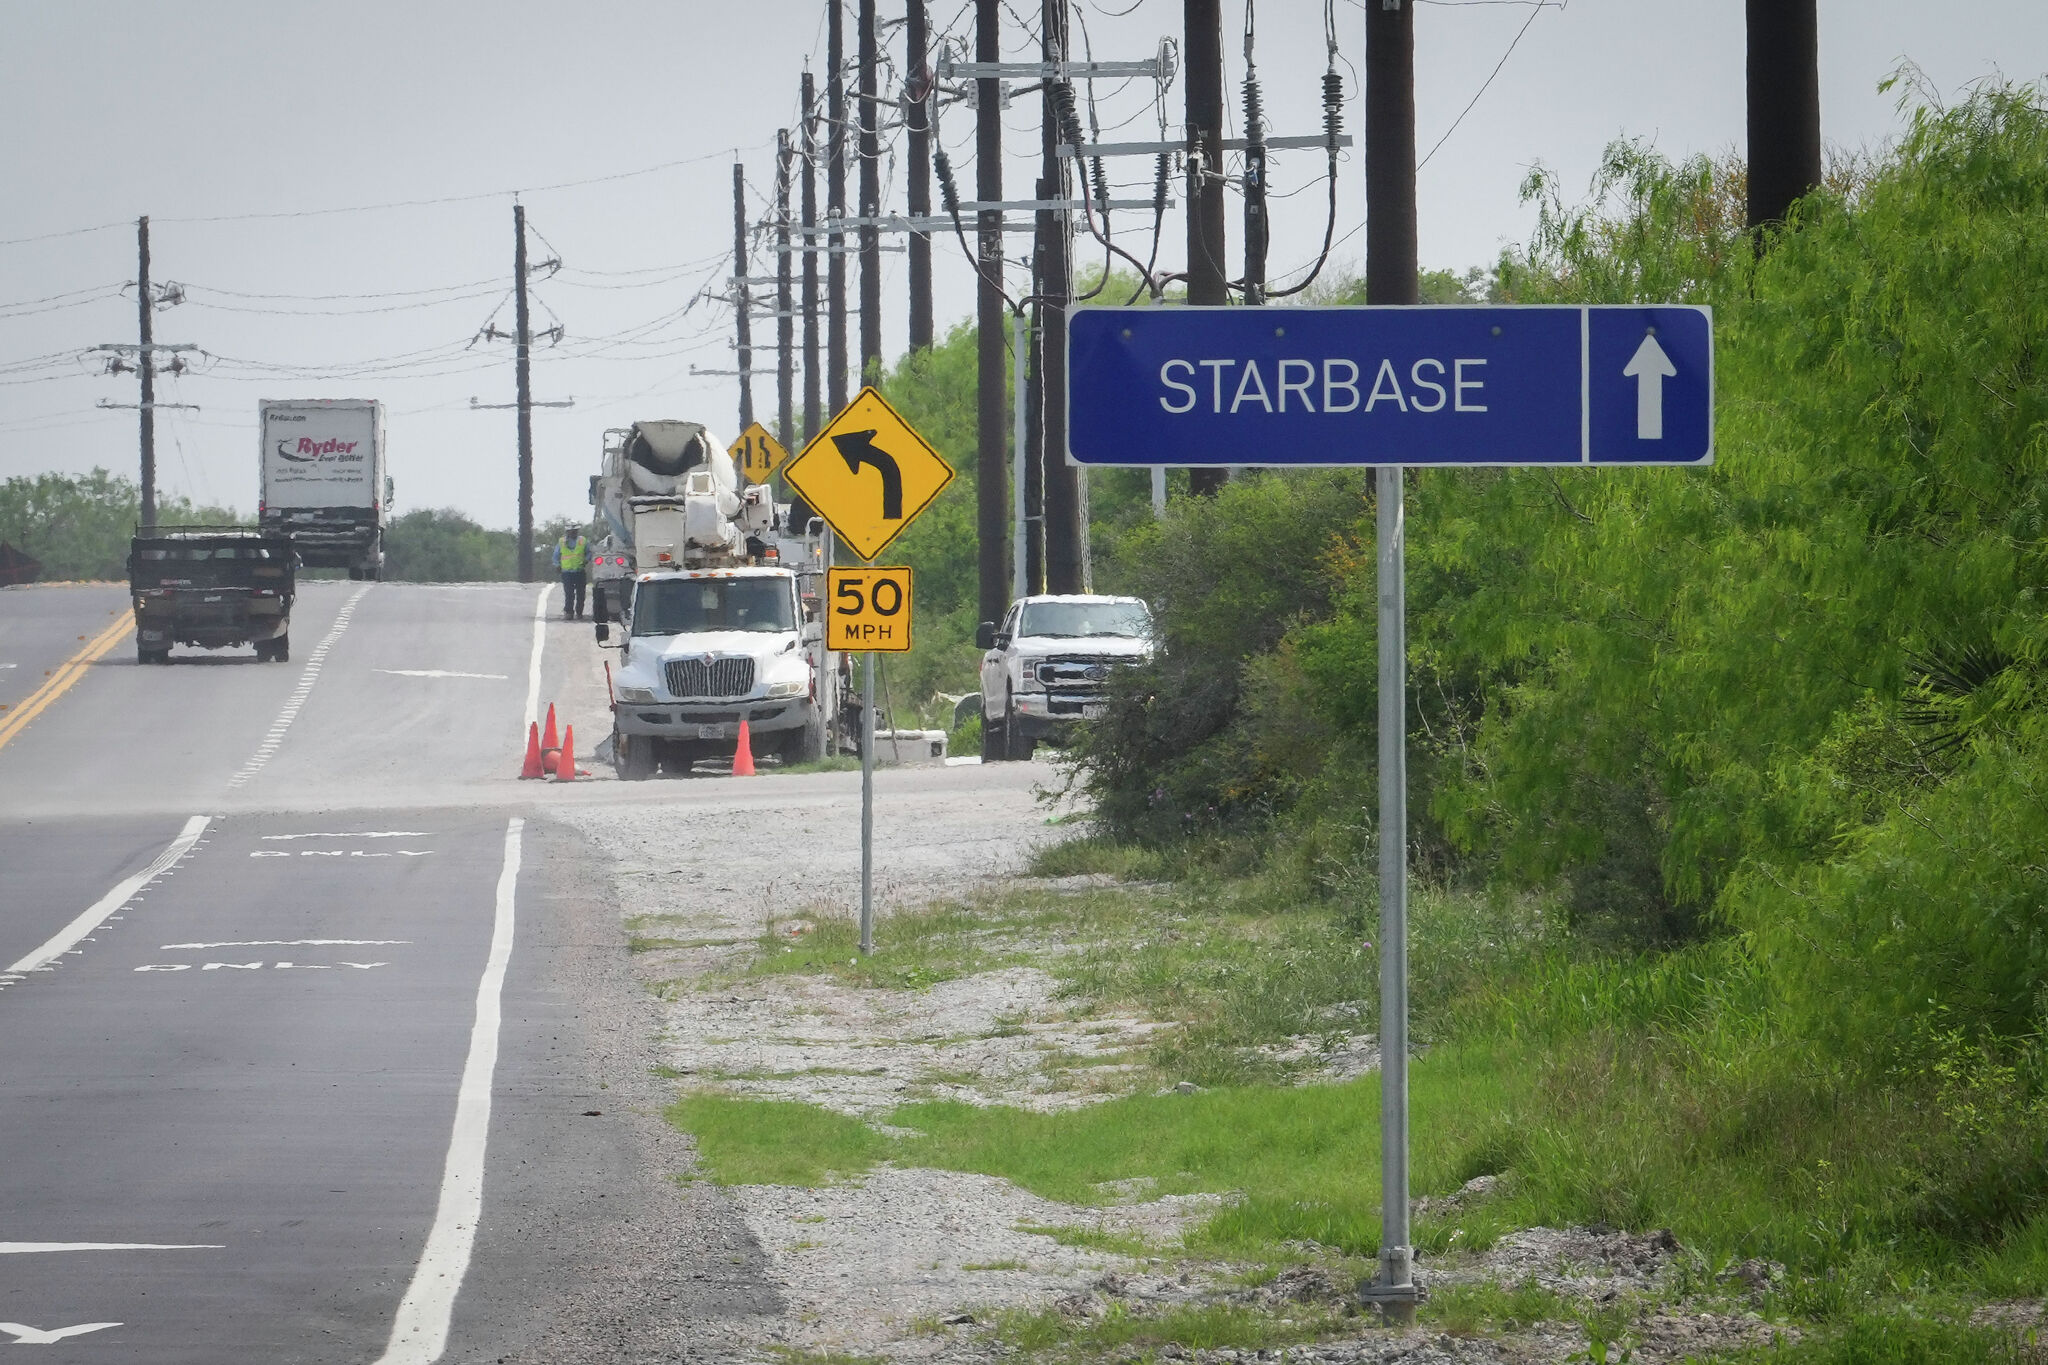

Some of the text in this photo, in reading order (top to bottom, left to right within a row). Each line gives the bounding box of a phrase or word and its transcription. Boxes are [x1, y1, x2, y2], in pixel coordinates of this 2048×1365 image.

[1159, 358, 1488, 414] STARBASE
[296, 437, 358, 457] Ryder
[836, 578, 902, 616] 50
[845, 624, 892, 639] MPH
[249, 849, 436, 858] ONLY
[133, 961, 391, 972] ONLY
